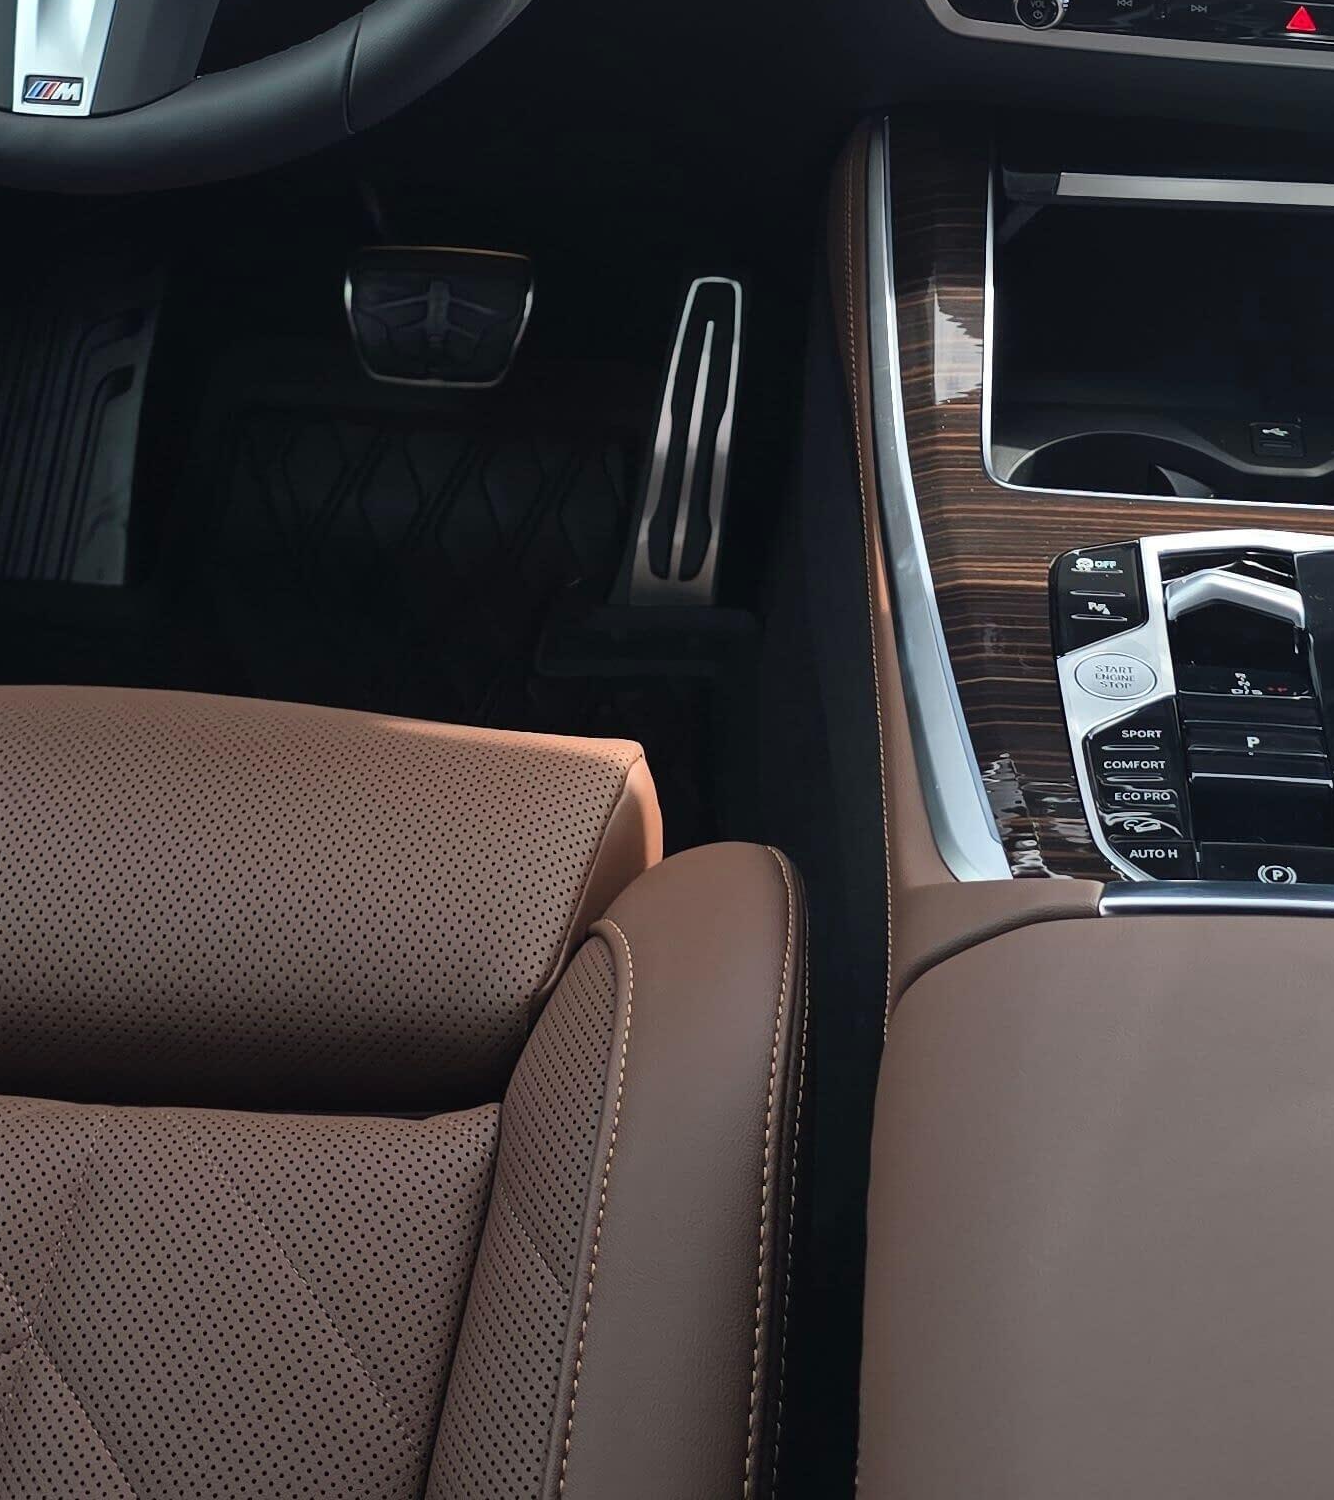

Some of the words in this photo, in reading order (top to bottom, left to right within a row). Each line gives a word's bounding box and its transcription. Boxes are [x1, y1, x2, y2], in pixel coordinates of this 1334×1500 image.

[1094, 560, 1117, 569] OFF
[1095, 665, 1136, 674] START
[1095, 673, 1136, 682] ENGINE
[1100, 681, 1133, 690] STOP
[1121, 729, 1163, 739] SPORT
[1246, 736, 1260, 748] P
[1103, 760, 1166, 770] COMFORT
[1114, 792, 1142, 801] ECO
[1143, 792, 1171, 801] PRO
[1129, 849, 1166, 859] AUTO
[1168, 849, 1178, 859] H
